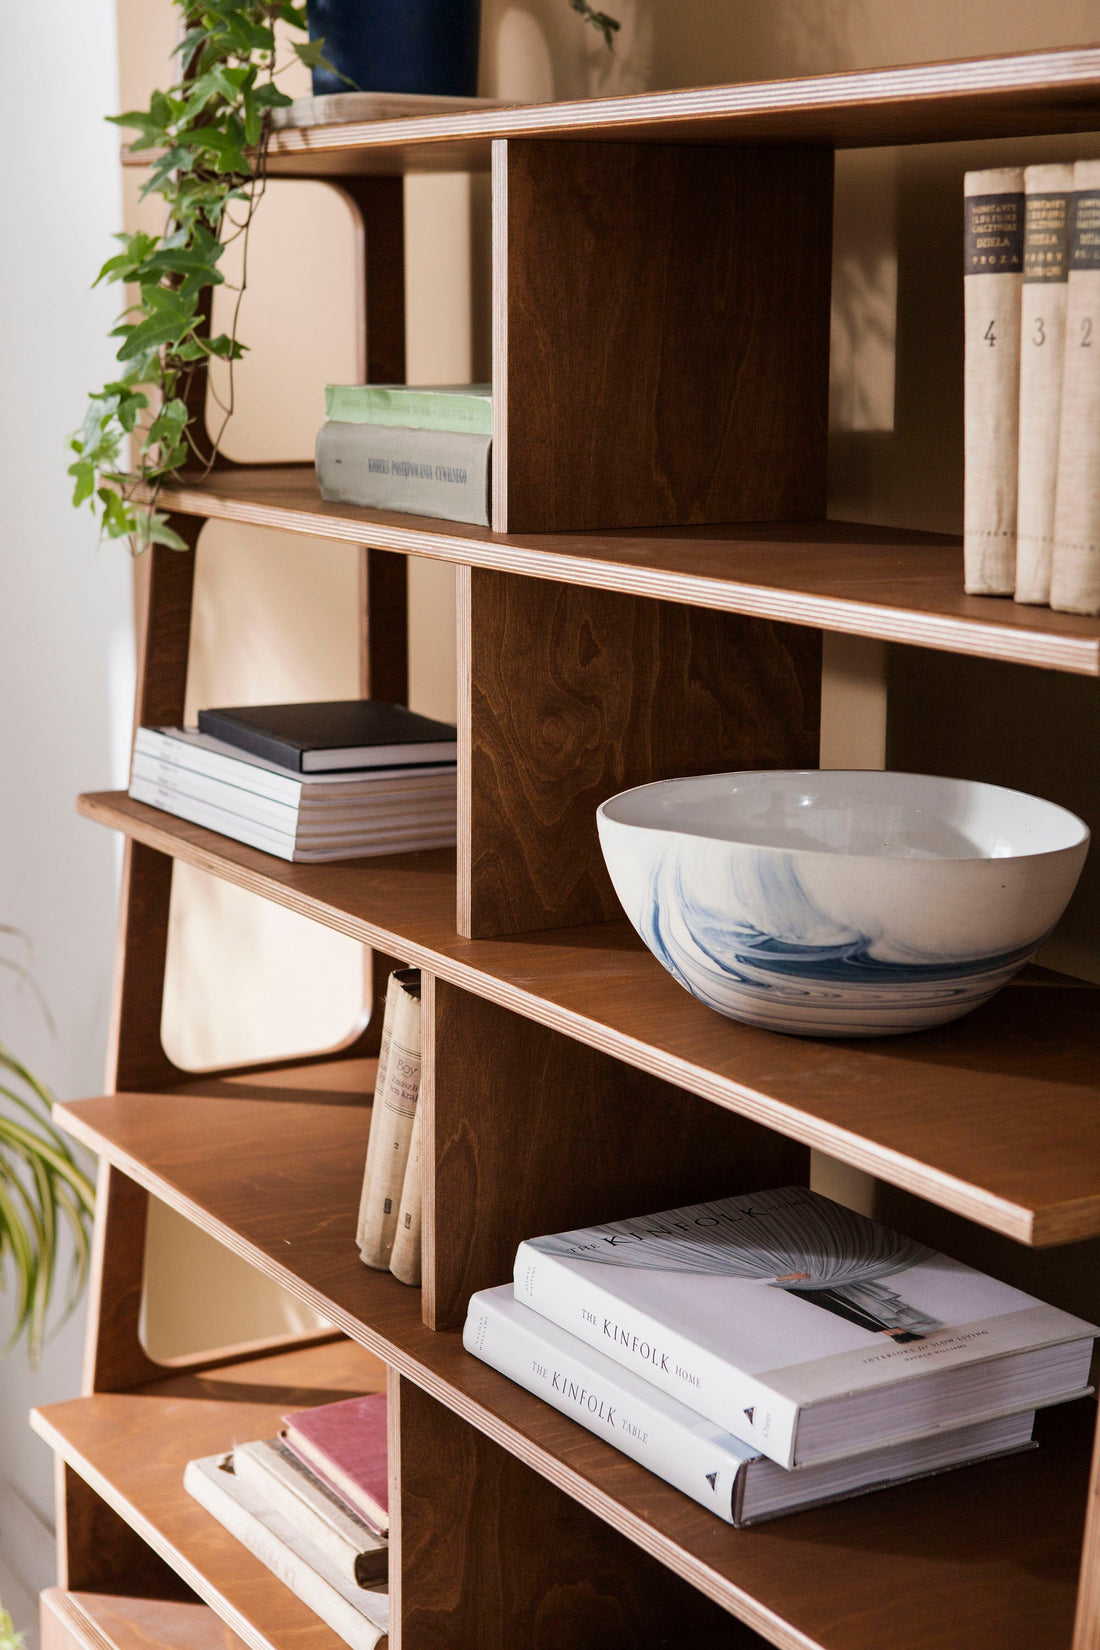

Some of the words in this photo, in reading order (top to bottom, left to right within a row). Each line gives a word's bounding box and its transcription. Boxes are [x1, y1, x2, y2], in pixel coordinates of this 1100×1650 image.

[983, 320, 997, 348] 4
[1032, 317, 1046, 347] 3
[1080, 317, 1094, 348] 2
[397, 1058, 418, 1078] Boy
[567, 1243, 600, 1254] THE
[603, 1207, 770, 1247] KINFOLK
[581, 1308, 597, 1326] THE
[603, 1319, 669, 1373] KINFOLK
[675, 1365, 702, 1388] HOME
[930, 1338, 954, 1348] SLOW
[956, 1330, 989, 1342] LIVING
[532, 1361, 548, 1379] THE
[552, 1371, 616, 1427] KINFOLK
[622, 1419, 648, 1444] TABLE
